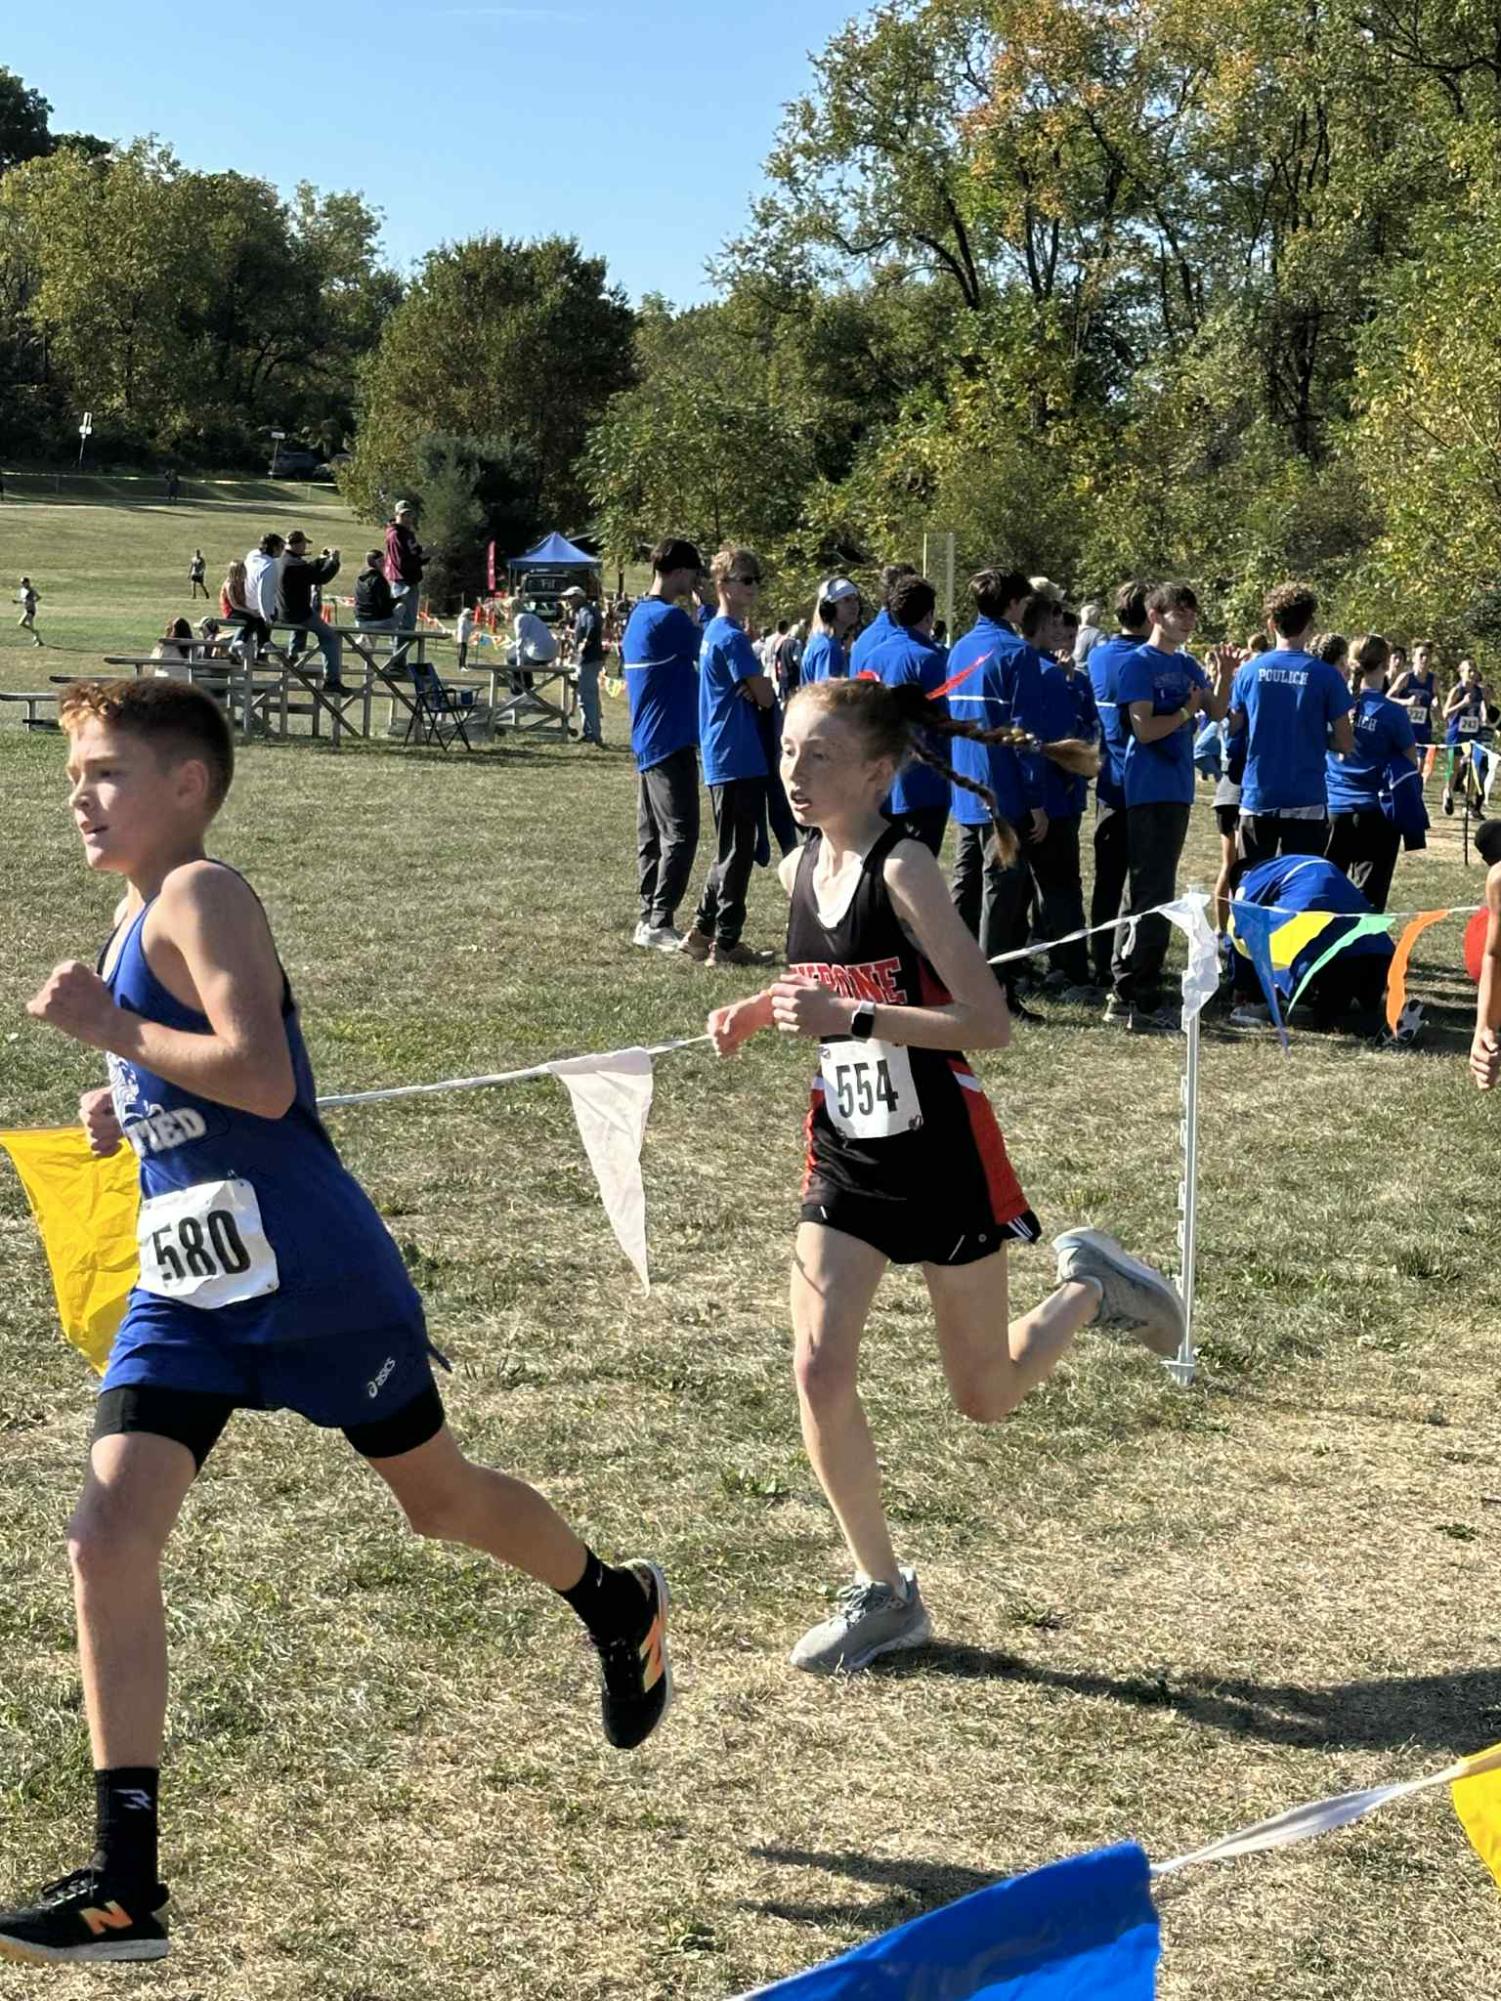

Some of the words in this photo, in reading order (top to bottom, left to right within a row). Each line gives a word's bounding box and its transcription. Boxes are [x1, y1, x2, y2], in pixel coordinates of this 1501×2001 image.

[789, 956, 908, 1005] RONE
[835, 1058, 899, 1118] 554
[152, 1210, 251, 1288] 580
